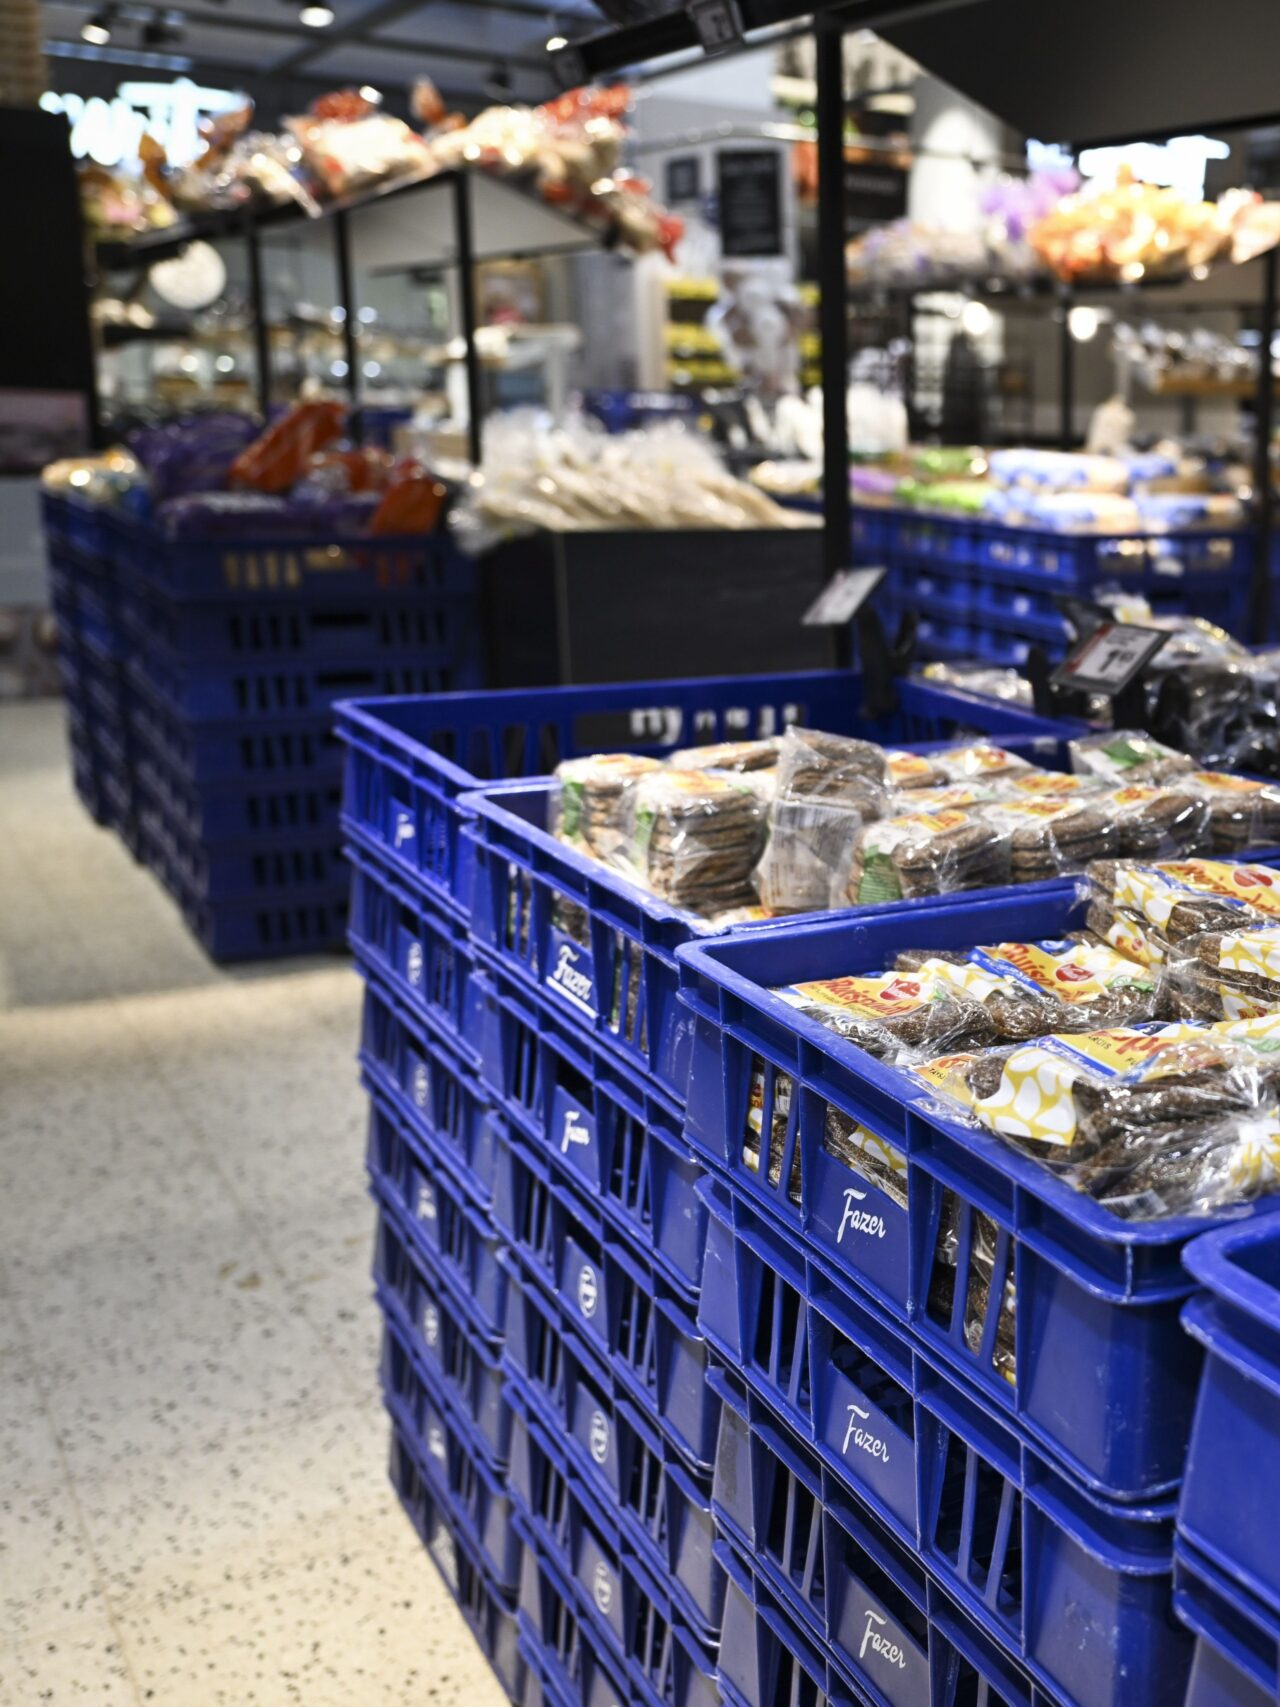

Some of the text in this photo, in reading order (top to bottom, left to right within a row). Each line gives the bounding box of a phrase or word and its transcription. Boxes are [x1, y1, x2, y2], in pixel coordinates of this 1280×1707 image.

[837, 1187, 886, 1244] Fazer
[842, 1404, 890, 1463] Fazer
[859, 1608, 907, 1669] Fazer
